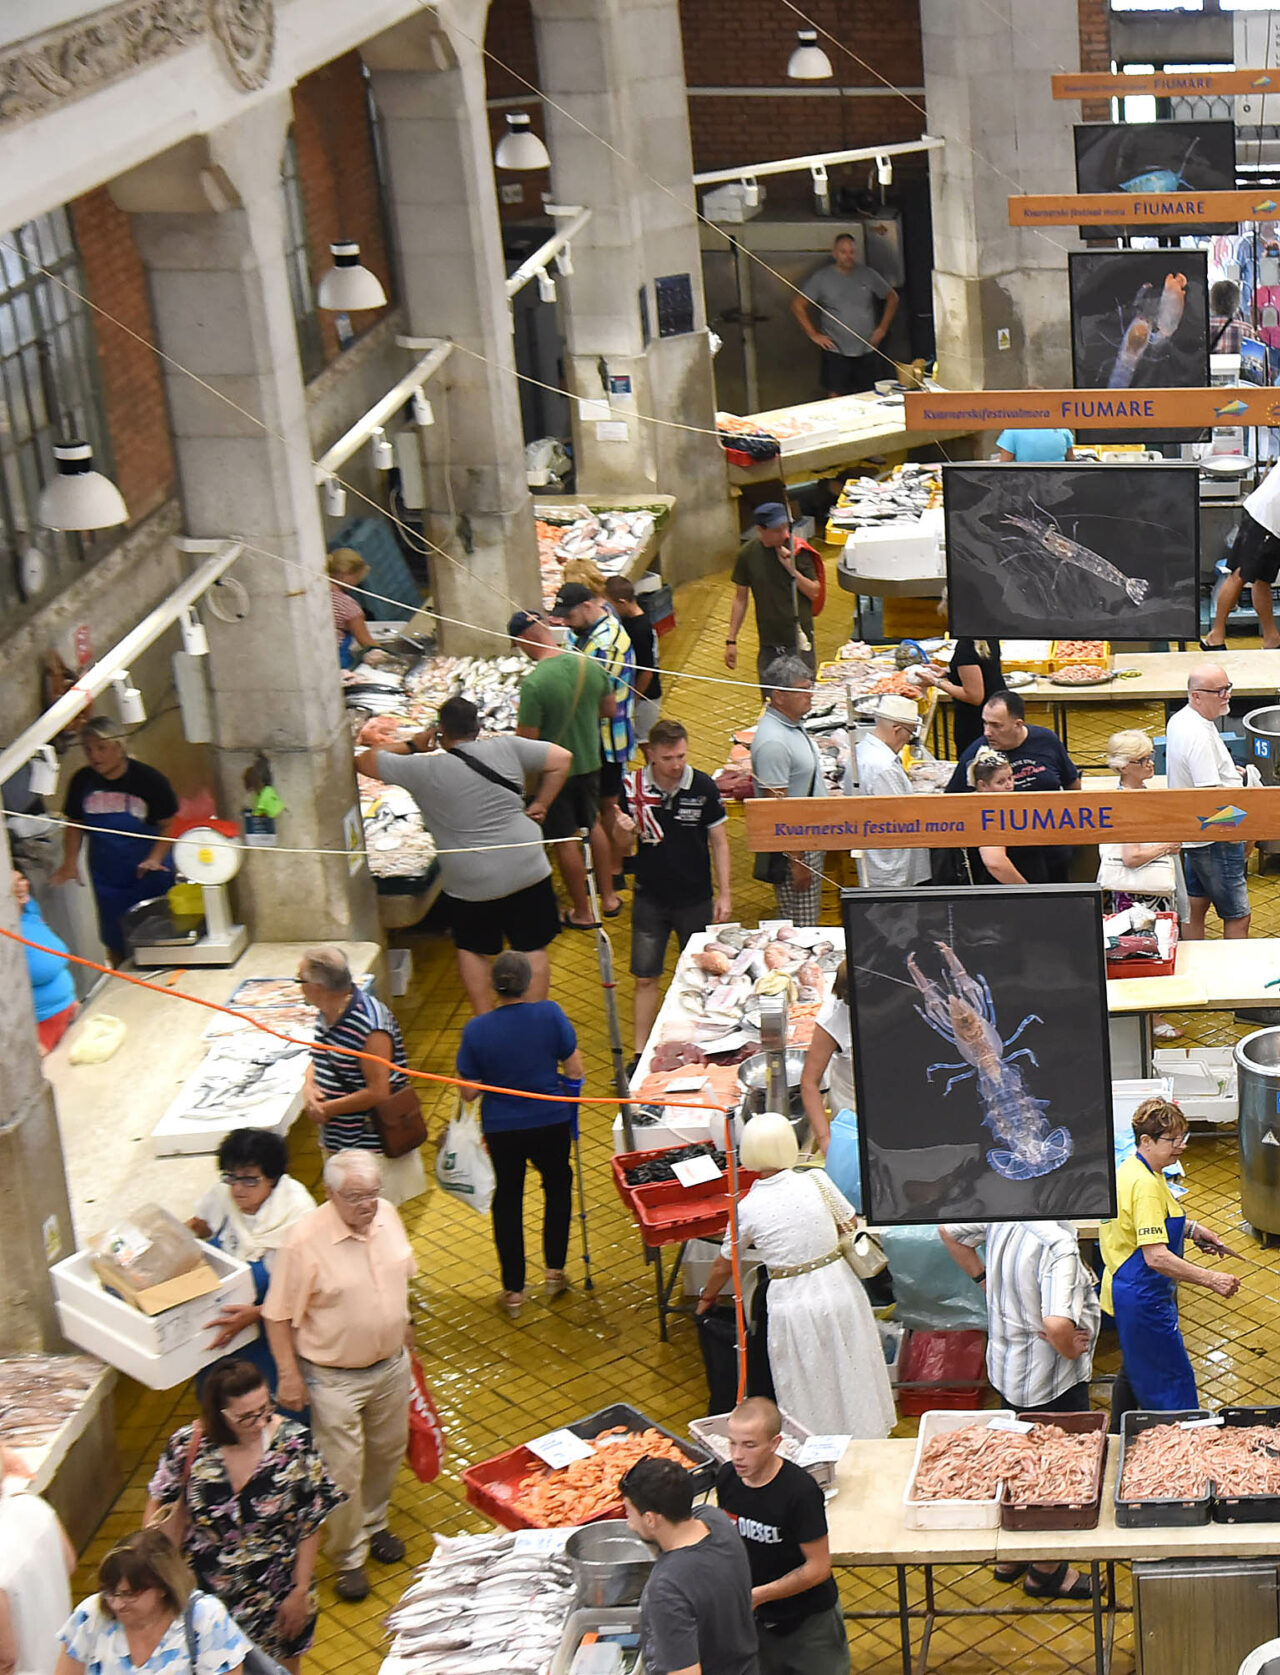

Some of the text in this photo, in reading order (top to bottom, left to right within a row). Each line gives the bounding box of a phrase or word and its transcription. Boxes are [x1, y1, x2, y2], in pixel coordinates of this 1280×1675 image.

[1154, 77, 1212, 89] FIUMARE
[1134, 201, 1205, 216] FIUMARE
[1061, 400, 1154, 418] FIUMARE
[1255, 739, 1268, 756] 15
[981, 806, 1115, 831] FIUMARE
[774, 819, 966, 838] Kvarnerski festival mora
[1138, 1226, 1164, 1236] CREW
[738, 1516, 784, 1544] DIESEL
